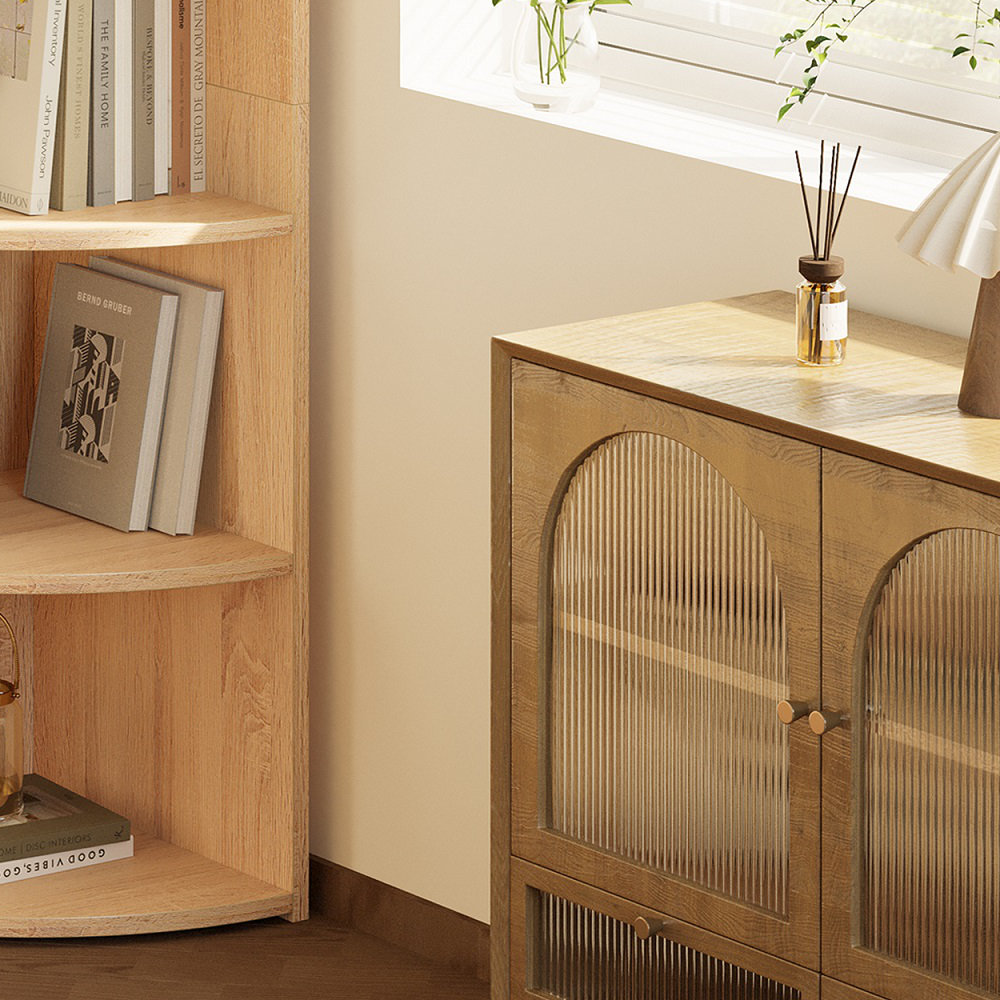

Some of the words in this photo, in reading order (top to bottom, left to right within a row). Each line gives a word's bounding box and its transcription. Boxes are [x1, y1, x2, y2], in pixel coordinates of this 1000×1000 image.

[48, 9, 62, 66] Inventory
[101, 19, 110, 42] THE
[100, 46, 109, 92] FAMILY
[194, 61, 204, 90] GRAY
[44, 95, 52, 126] John
[100, 93, 109, 128] HOME
[194, 97, 204, 112] DE
[40, 129, 50, 179] Pawson
[194, 116, 204, 168] SECRETO
[194, 171, 204, 180] EL
[76, 291, 102, 306] BERND
[102, 299, 132, 315] GRUBER
[24, 858, 64, 872] VIBES,
[68, 848, 106, 864] GOOD
